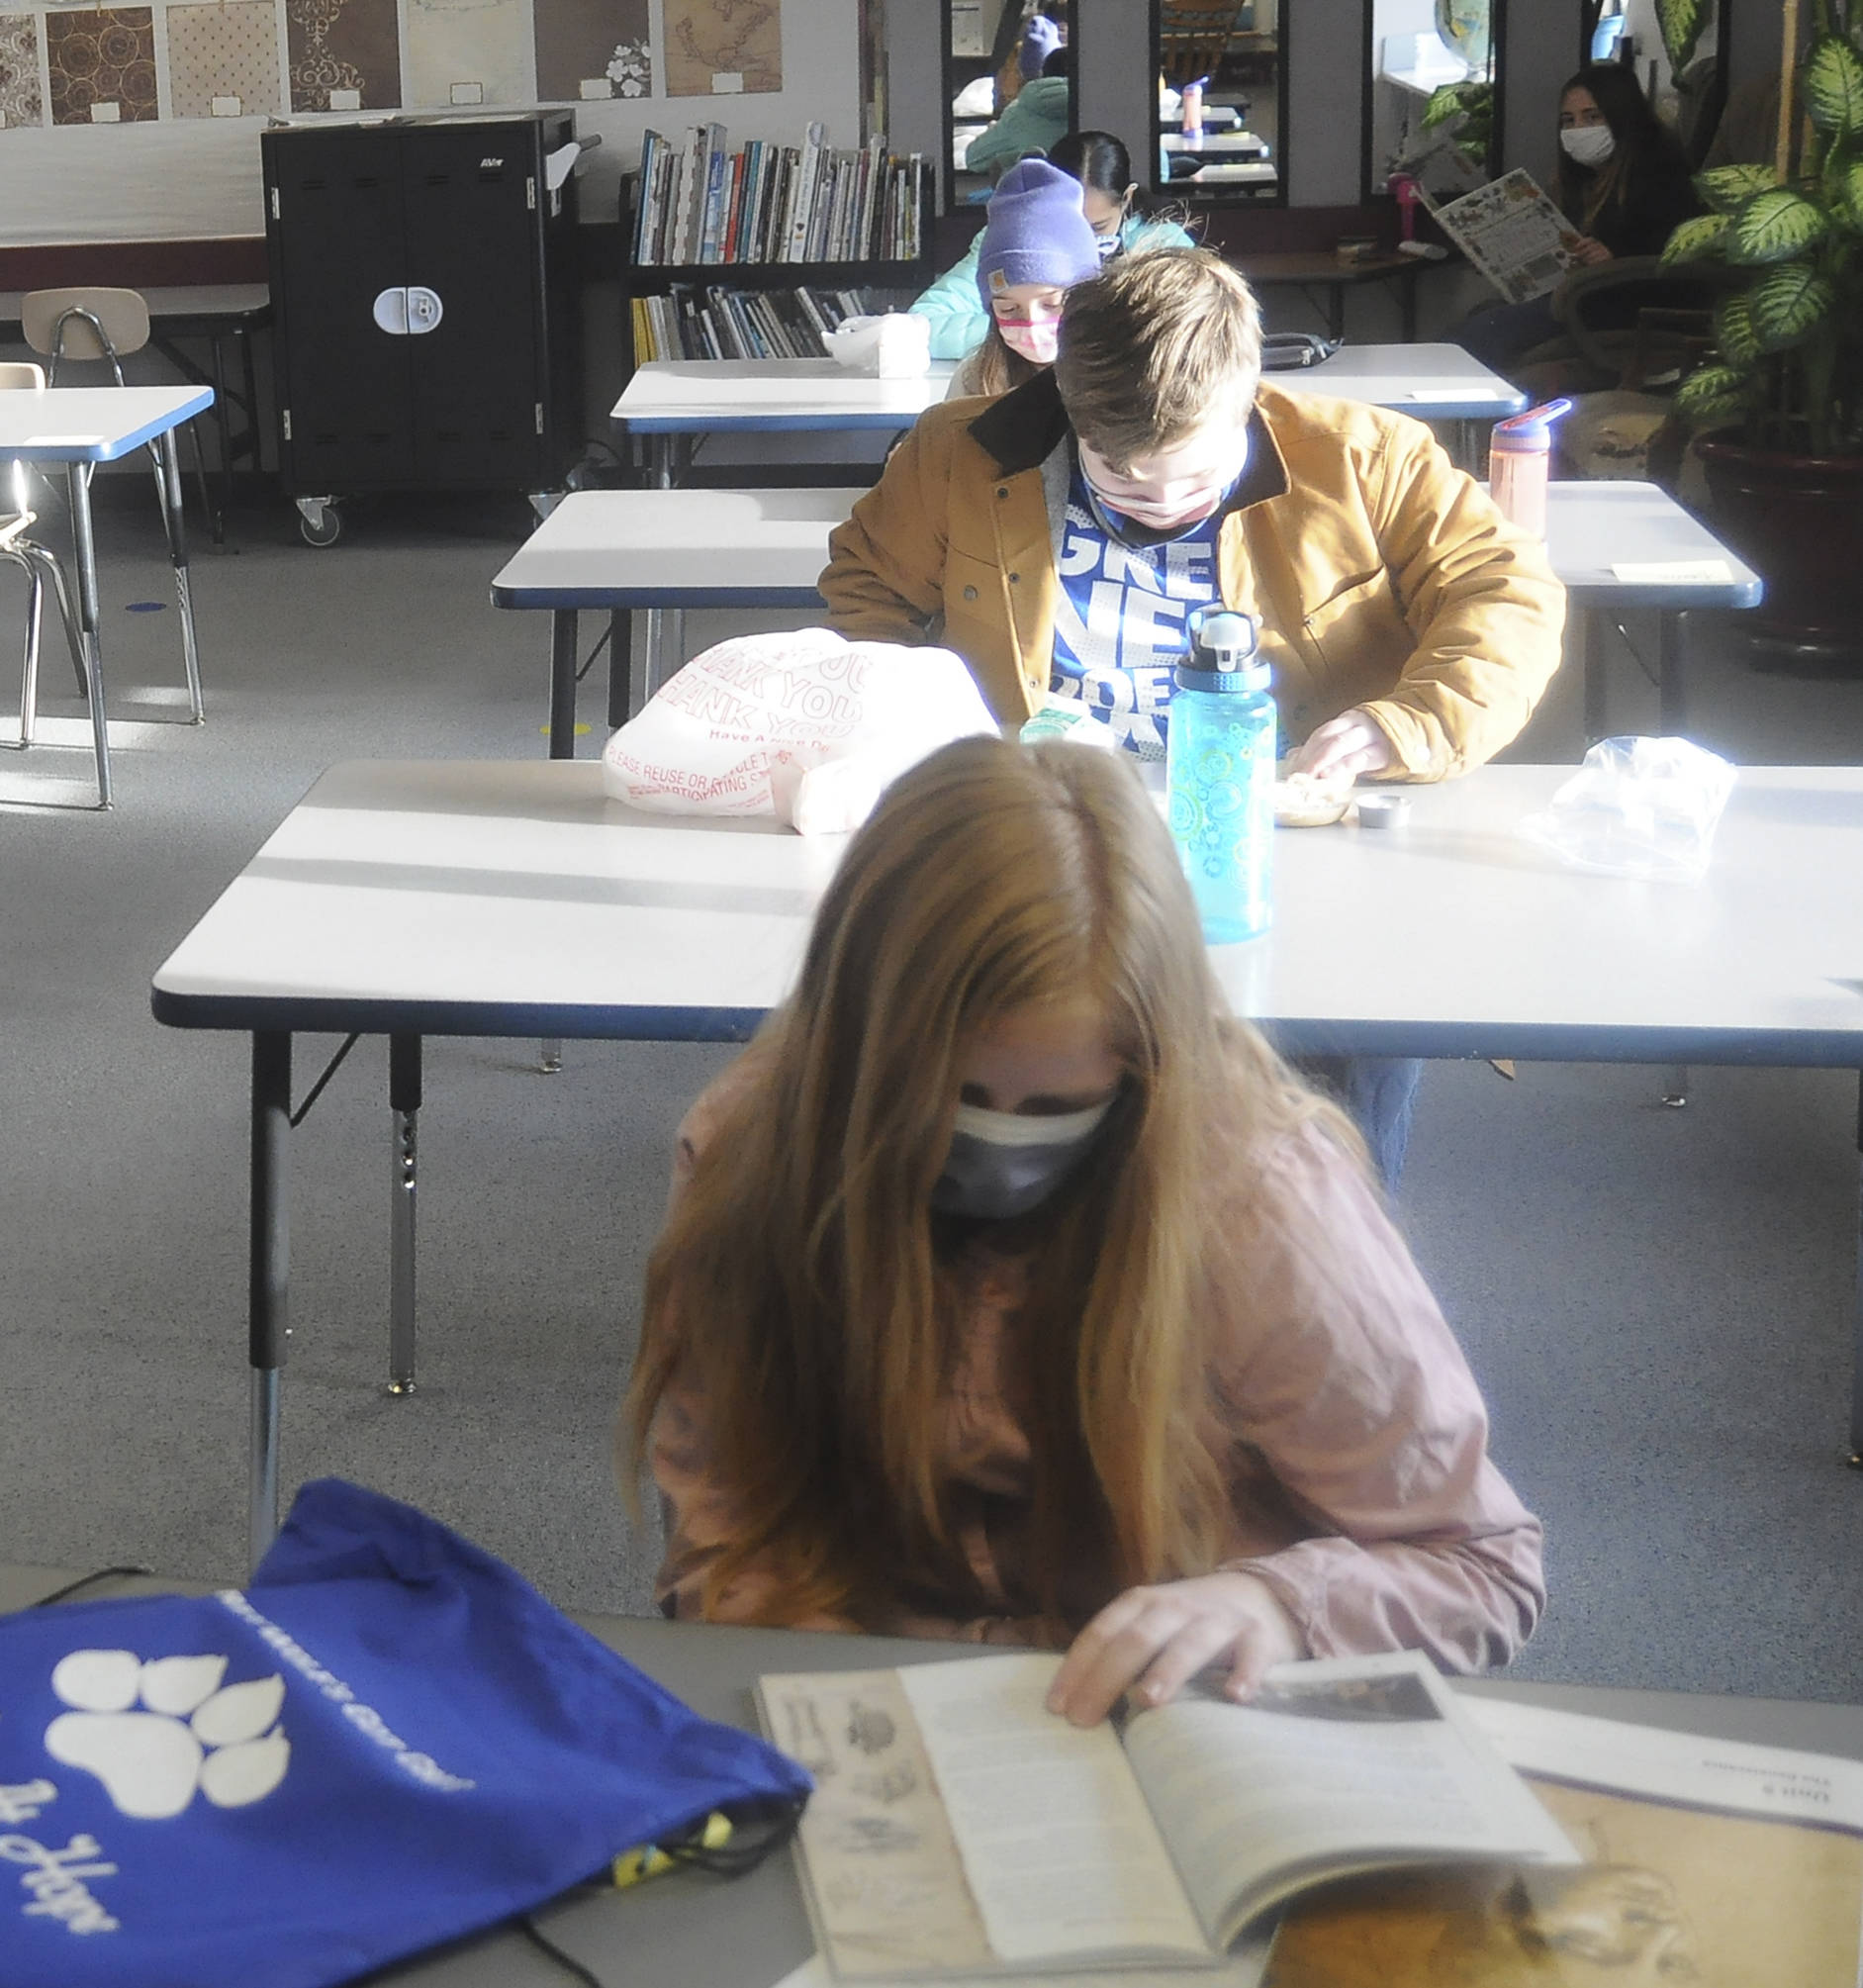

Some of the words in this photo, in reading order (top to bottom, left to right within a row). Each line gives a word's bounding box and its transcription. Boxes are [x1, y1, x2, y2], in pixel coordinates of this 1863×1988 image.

[708, 729, 750, 743] Have
[643, 764, 686, 786] REUSE
[688, 773, 709, 791] OR
